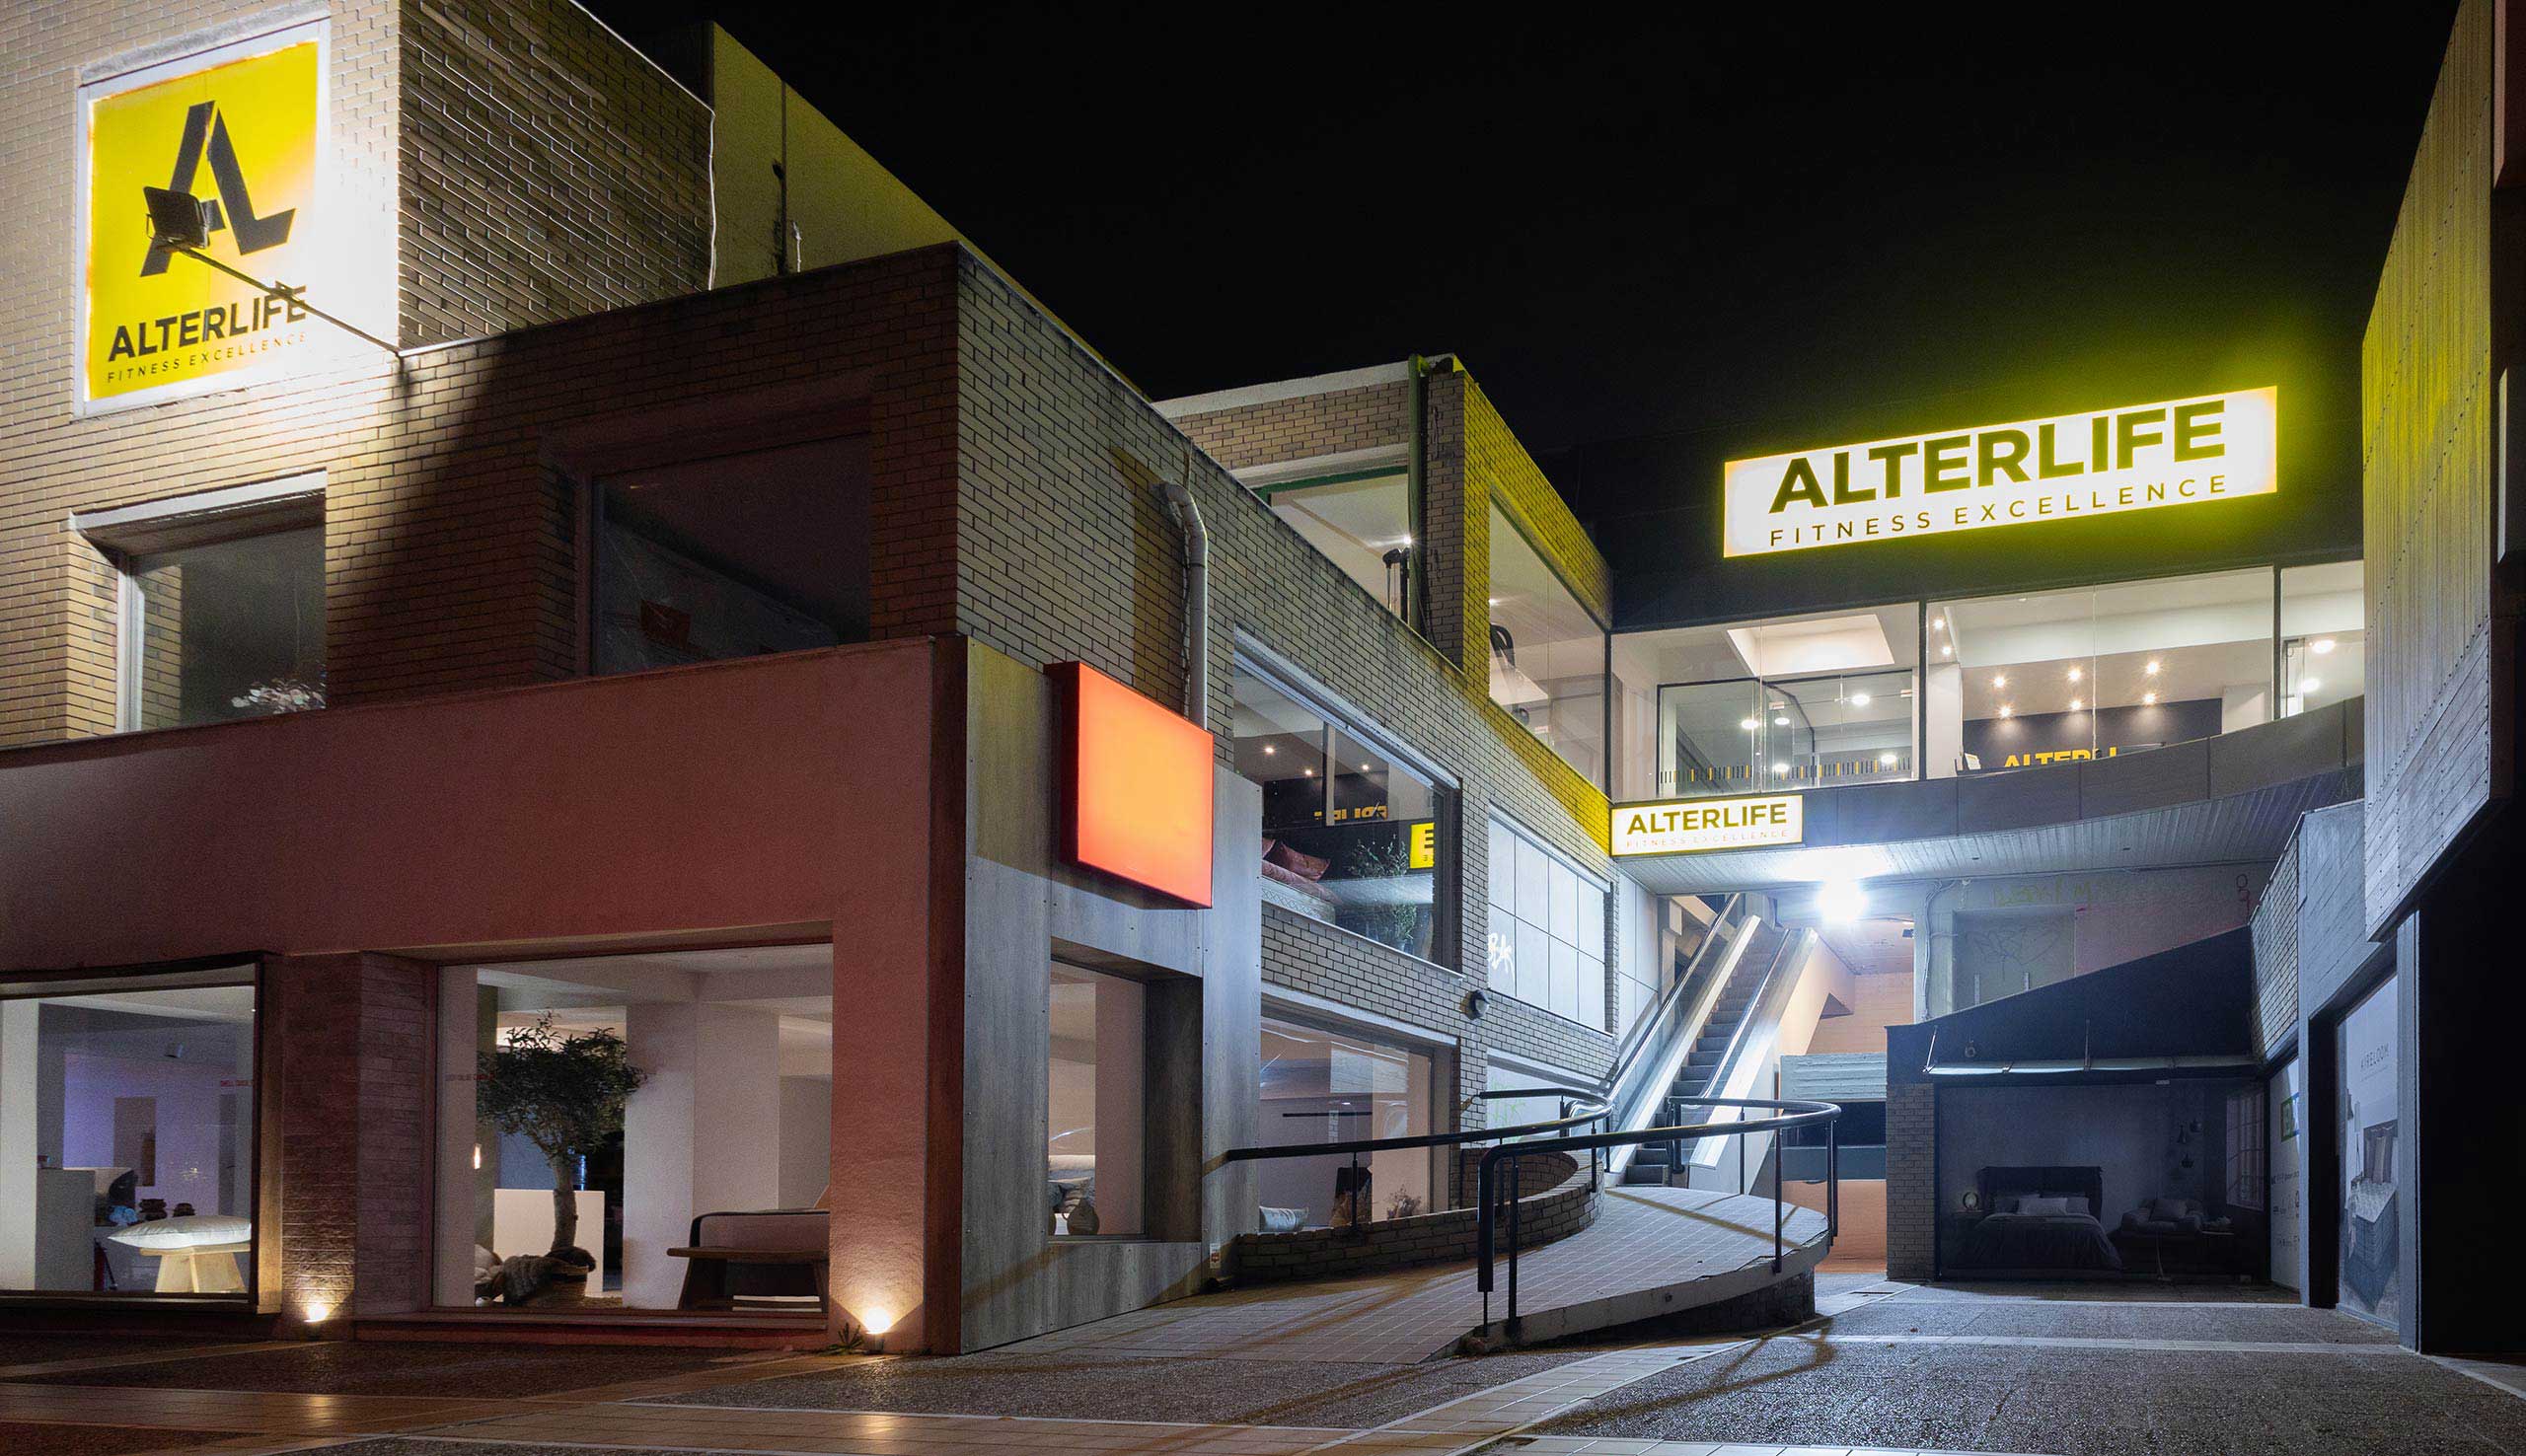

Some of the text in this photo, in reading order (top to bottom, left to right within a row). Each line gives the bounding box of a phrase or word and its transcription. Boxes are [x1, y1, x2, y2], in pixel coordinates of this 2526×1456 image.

[108, 285, 306, 362] ALTERLIFE
[108, 331, 306, 384] FITNESS EXCELLENCE
[1768, 400, 2225, 514] ALTERLIFE
[1770, 474, 2226, 546] FITNESS EXCELLENCE
[1626, 803, 1788, 836] ALTERLIFE
[1626, 837, 1686, 848] FITNESS
